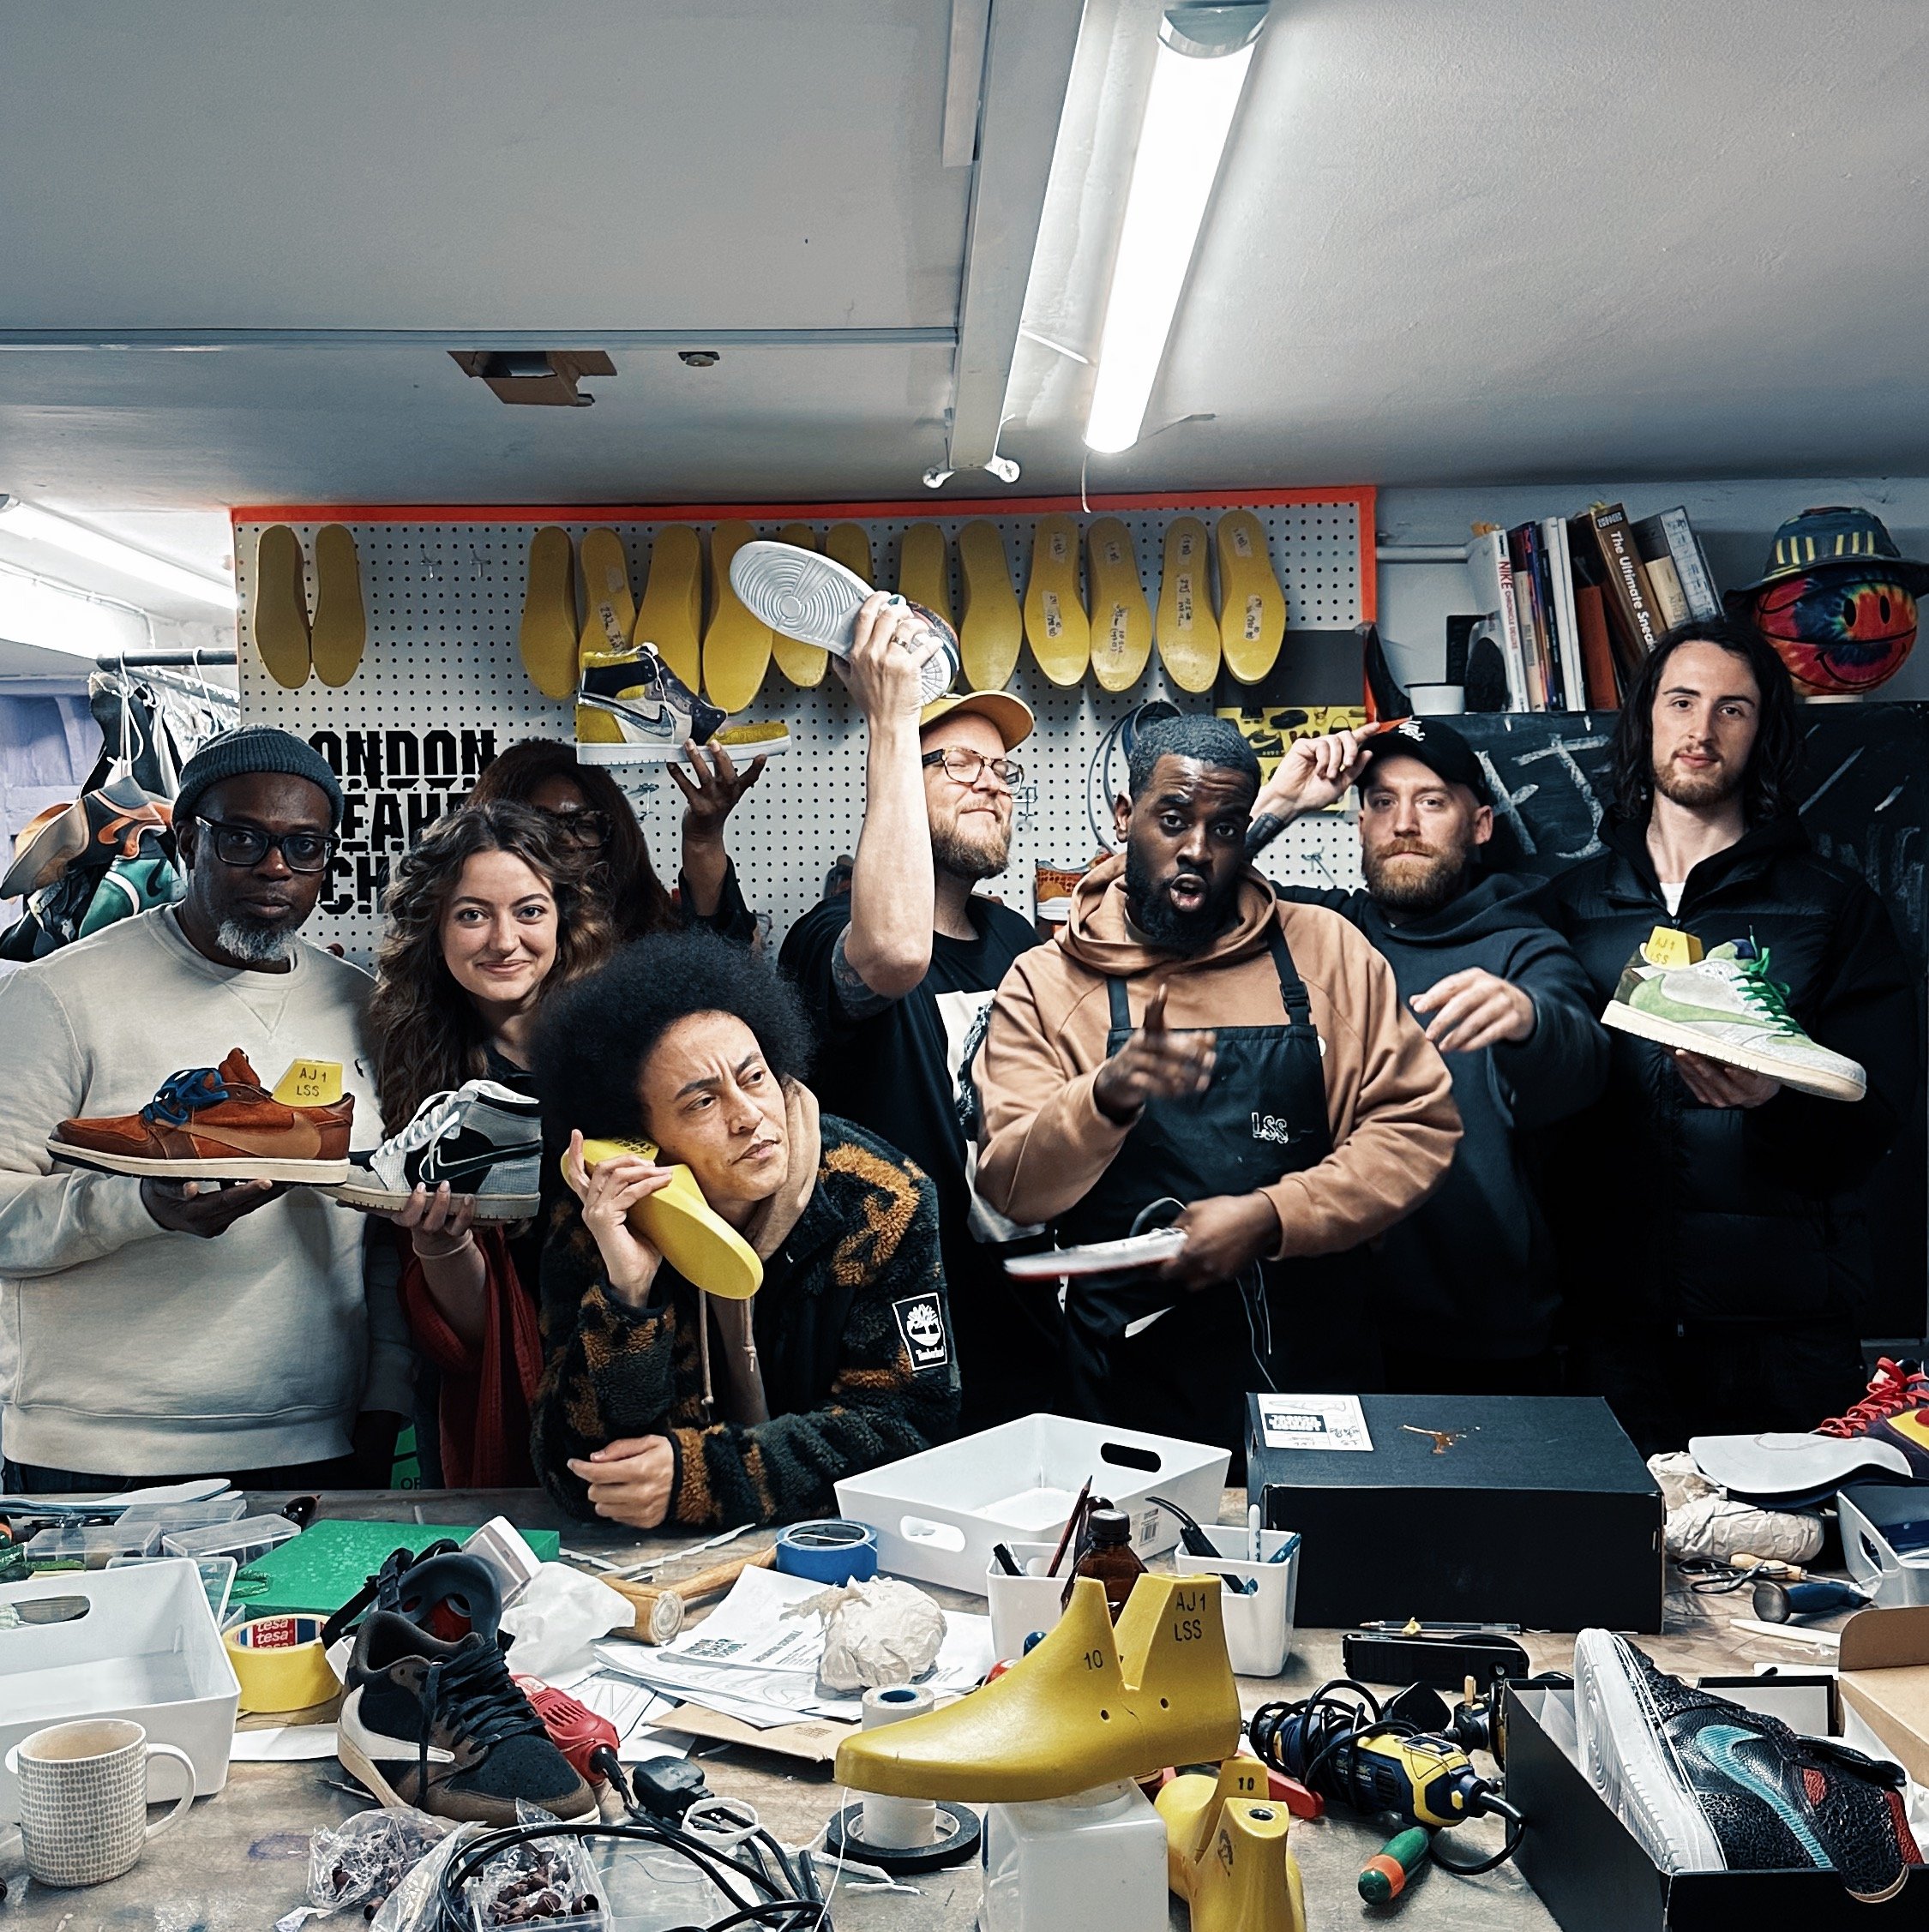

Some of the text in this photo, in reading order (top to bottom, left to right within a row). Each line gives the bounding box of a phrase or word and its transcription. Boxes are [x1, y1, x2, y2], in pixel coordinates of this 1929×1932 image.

[1499, 561, 1513, 589] NIKE
[1611, 531, 1625, 554] The
[1620, 556, 1643, 609] Ultimate
[308, 729, 496, 789] ONDON
[296, 1084, 320, 1097] LSS
[1251, 1112, 1289, 1144] LSS
[1174, 1618, 1203, 1641] LSS
[1083, 1649, 1103, 1670] 10
[1238, 1777, 1255, 1791] 10
